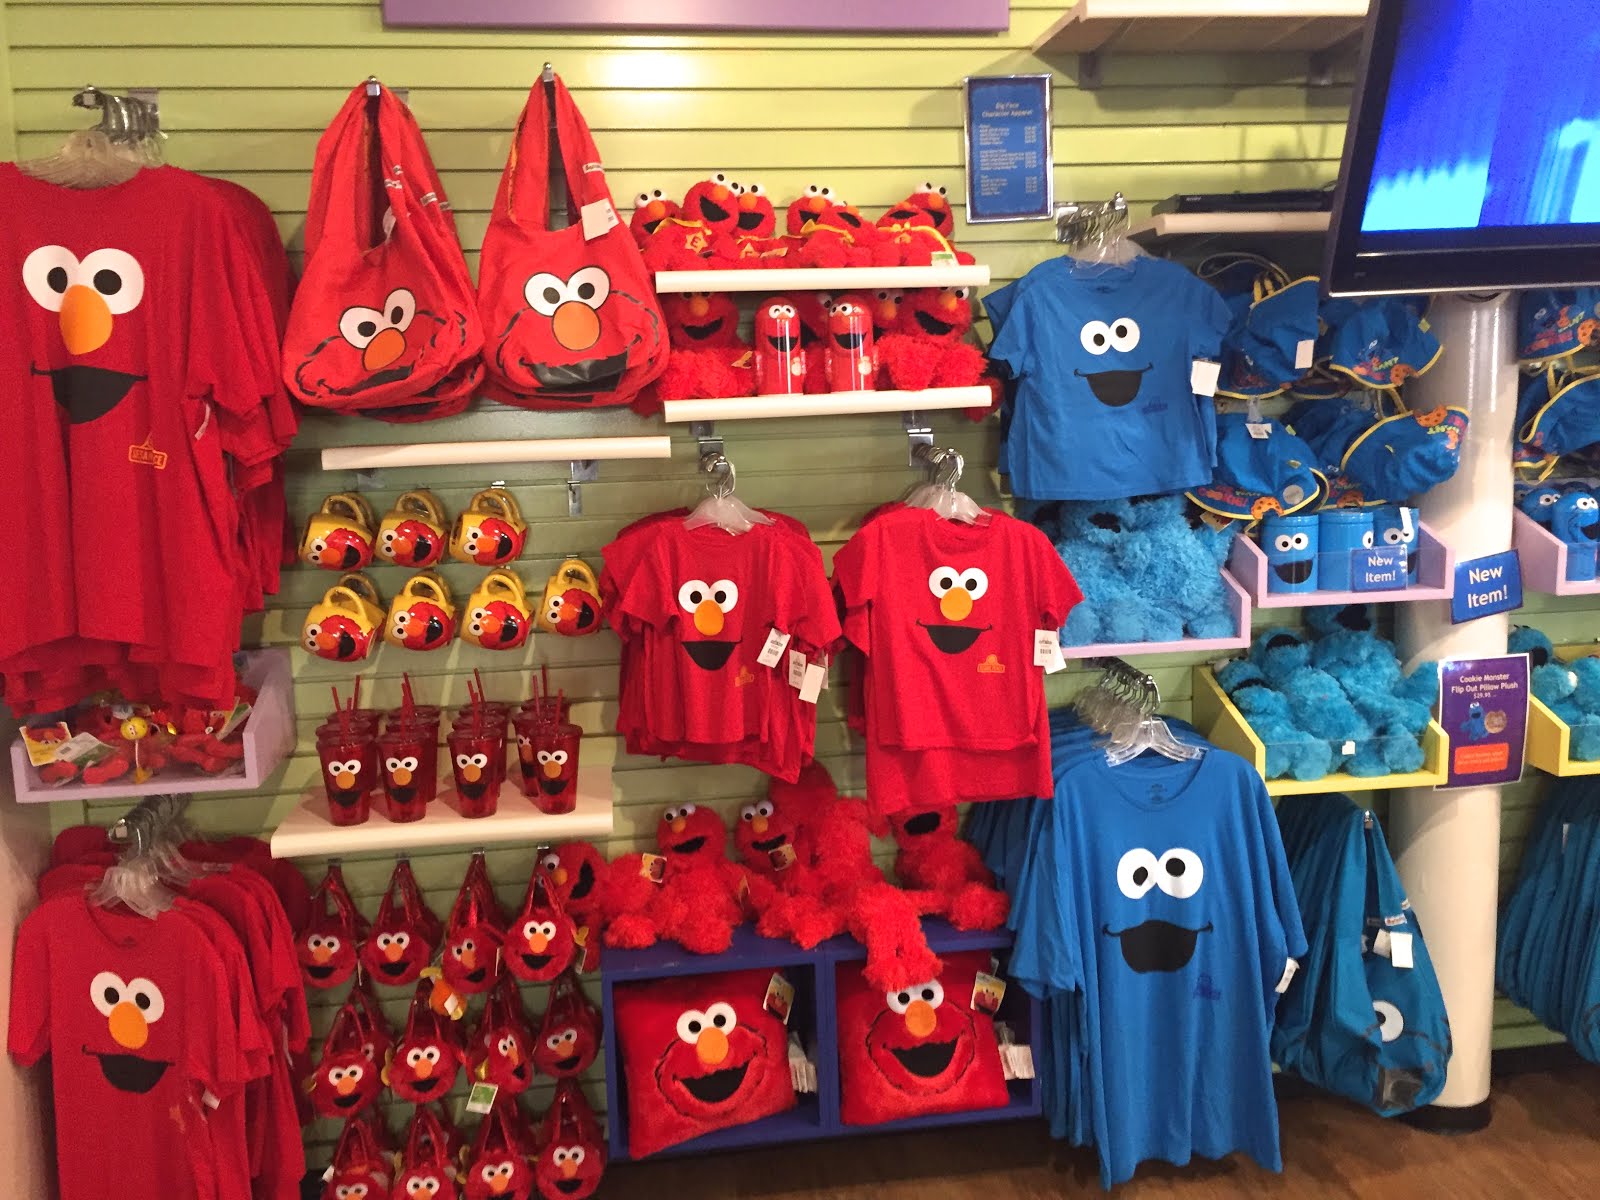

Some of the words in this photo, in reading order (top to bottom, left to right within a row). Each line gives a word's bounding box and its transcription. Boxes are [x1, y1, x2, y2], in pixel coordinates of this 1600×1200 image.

[1367, 556, 1393, 567] New
[1365, 571, 1396, 583] Item!
[1469, 566, 1503, 584] New
[1467, 584, 1508, 609] Item!
[1459, 675, 1482, 683] Cookie
[1483, 673, 1510, 681] Monster
[1451, 685, 1465, 694] Flip
[1465, 685, 1478, 693] Out
[1479, 683, 1499, 691] Pillow
[1500, 681, 1519, 690] Plush
